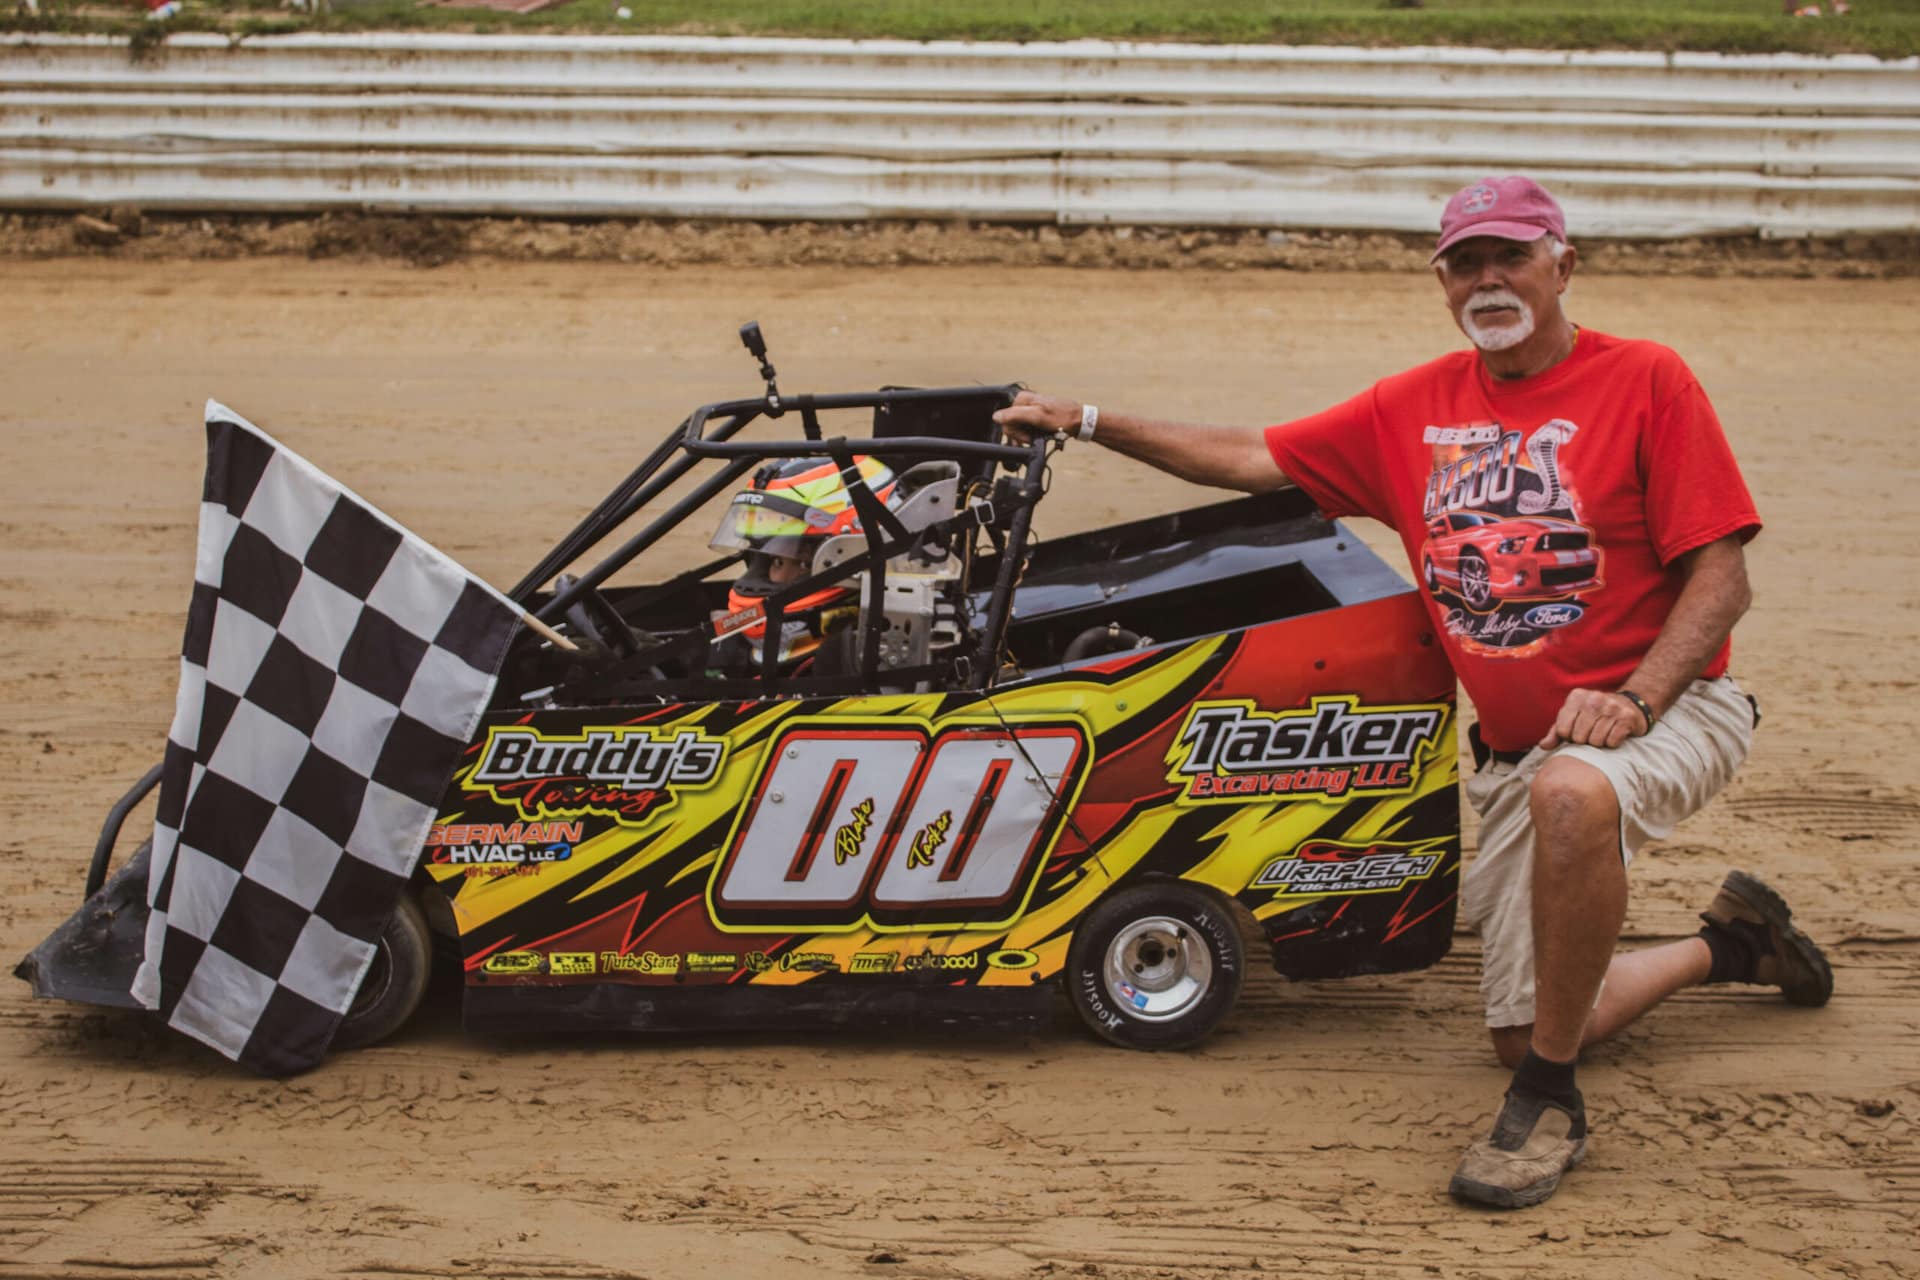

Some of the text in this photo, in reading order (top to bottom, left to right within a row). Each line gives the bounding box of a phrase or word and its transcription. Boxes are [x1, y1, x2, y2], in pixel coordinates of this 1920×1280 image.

[1535, 607, 1572, 625] Ford
[474, 732, 724, 789] Buddy's
[1180, 702, 1441, 773] Tasker
[1189, 767, 1350, 796] Excavating
[424, 822, 584, 846] GERMAIN
[719, 730, 1081, 908] 00
[834, 798, 874, 865] Blake
[907, 810, 952, 869] Tasker
[450, 844, 556, 863] HVAC LLC
